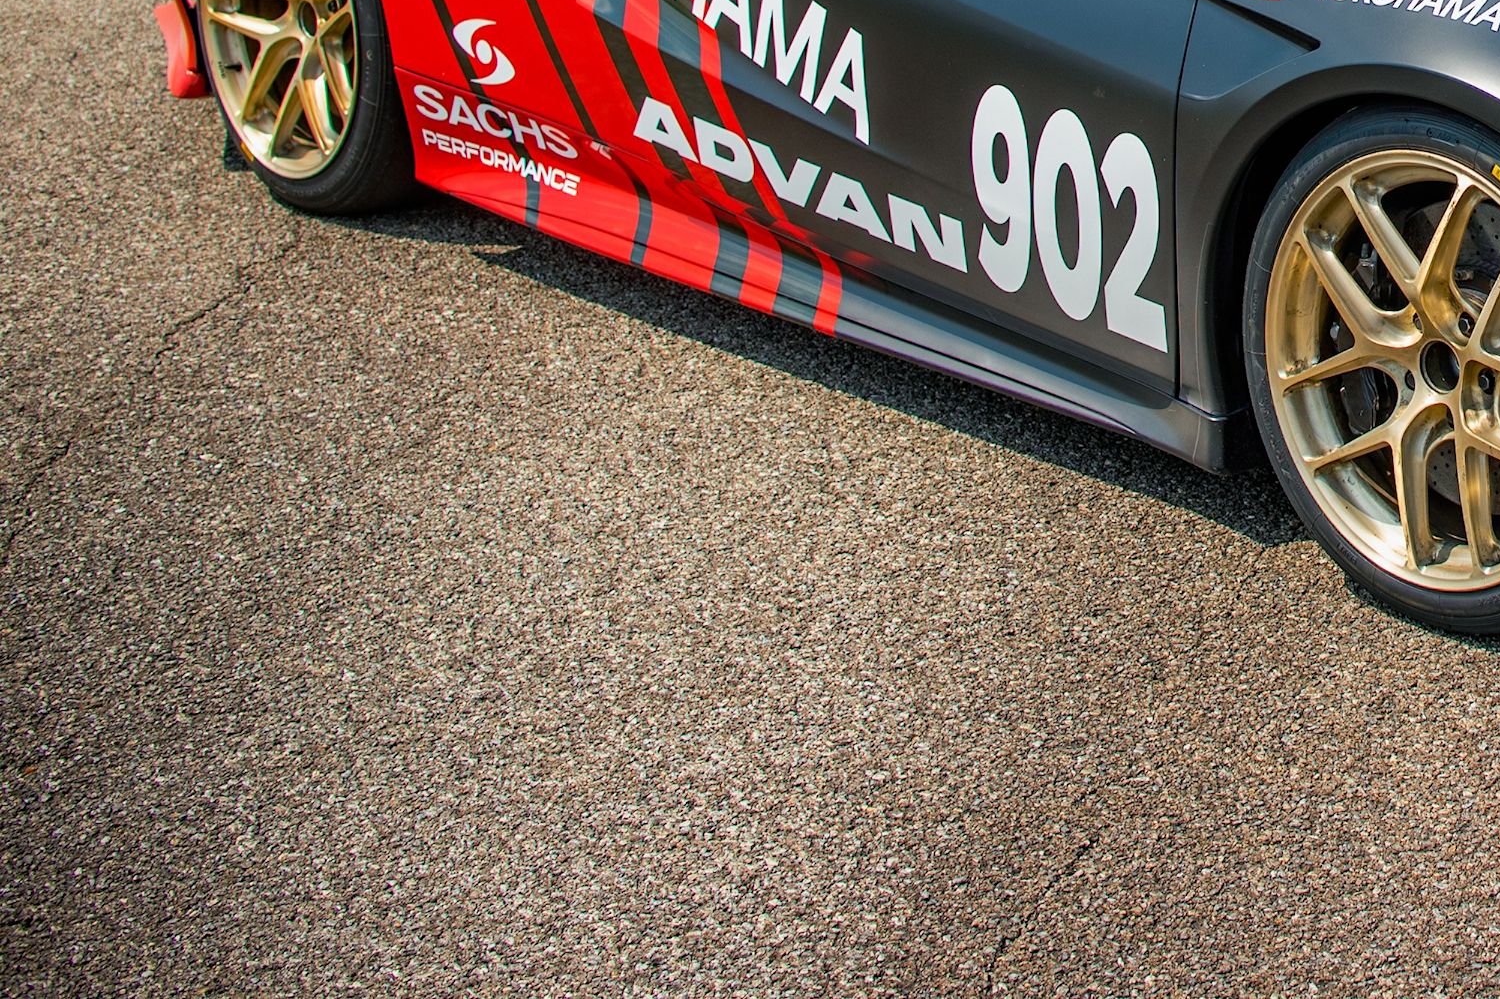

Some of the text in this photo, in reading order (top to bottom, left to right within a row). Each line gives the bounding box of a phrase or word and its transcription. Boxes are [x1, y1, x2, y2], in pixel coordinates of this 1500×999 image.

[414, 84, 578, 159] SACHS
[422, 129, 580, 196] PERFORMANCE
[634, 97, 968, 274] ADVAN
[971, 85, 1168, 354] 902
